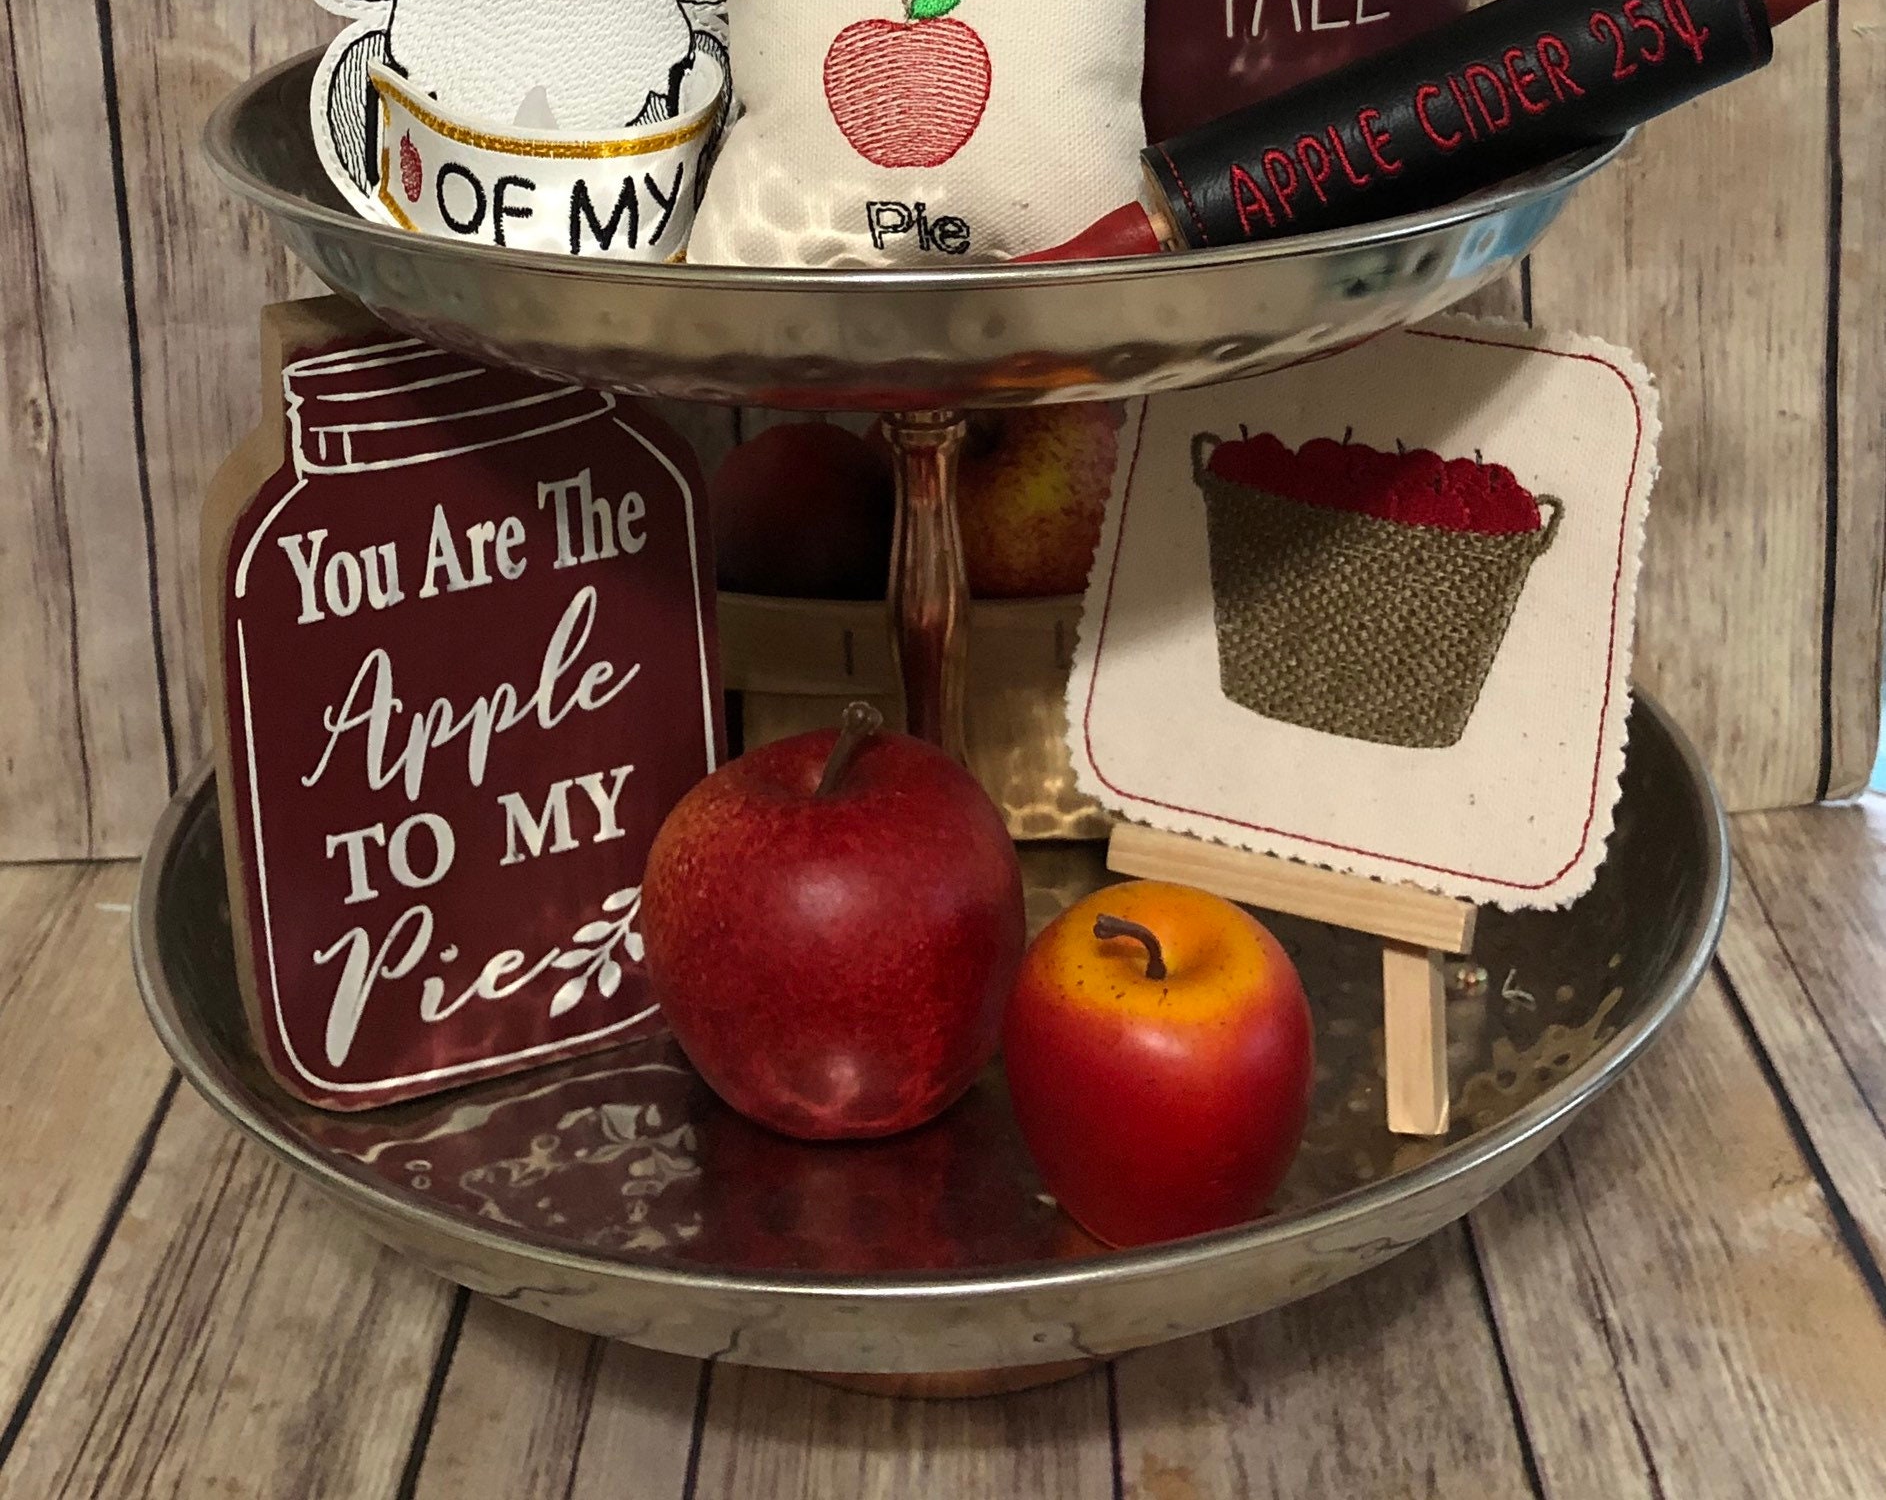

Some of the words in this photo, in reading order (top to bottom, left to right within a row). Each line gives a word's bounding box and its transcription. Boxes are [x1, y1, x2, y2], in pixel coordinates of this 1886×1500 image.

[435, 161, 537, 249] OF
[568, 163, 685, 255] MY
[1228, 105, 1401, 235] APPLE
[1413, 34, 1585, 150] CIDER
[866, 200, 973, 255] Pie
[277, 528, 404, 624] You
[417, 503, 527, 601] Are
[536, 467, 648, 571] The
[301, 585, 640, 801] Apple
[326, 813, 456, 905] TO
[498, 764, 635, 866] MY
[313, 905, 560, 1068] Pie
